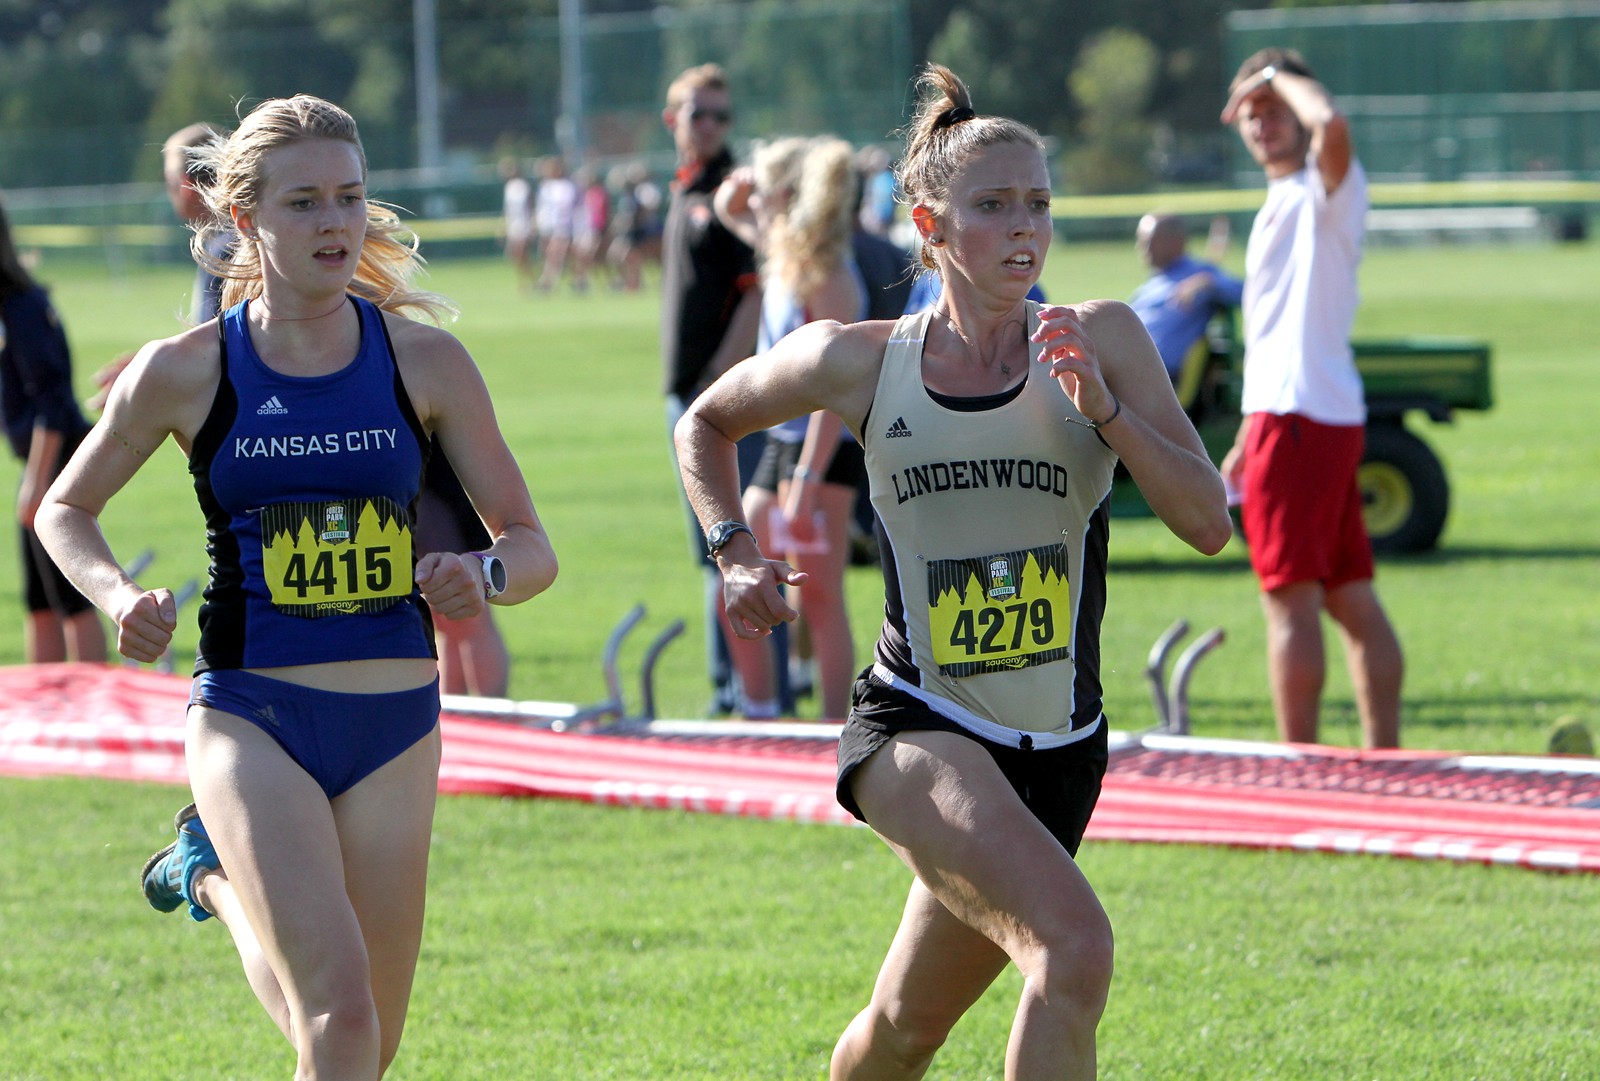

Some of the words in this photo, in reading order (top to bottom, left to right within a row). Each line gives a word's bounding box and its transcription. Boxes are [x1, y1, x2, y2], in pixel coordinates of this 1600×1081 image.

[256, 407, 288, 415] adidas
[885, 429, 912, 439] adidas
[234, 433, 340, 458] KANSAS
[346, 428, 397, 452] CITY
[891, 458, 1068, 505] LINDENWOOD
[326, 513, 344, 521] PARK
[283, 546, 392, 598] 4415
[991, 569, 1008, 578] PARK
[316, 601, 353, 611] saucony
[950, 598, 1055, 656] 4279
[985, 656, 1021, 667] saucony
